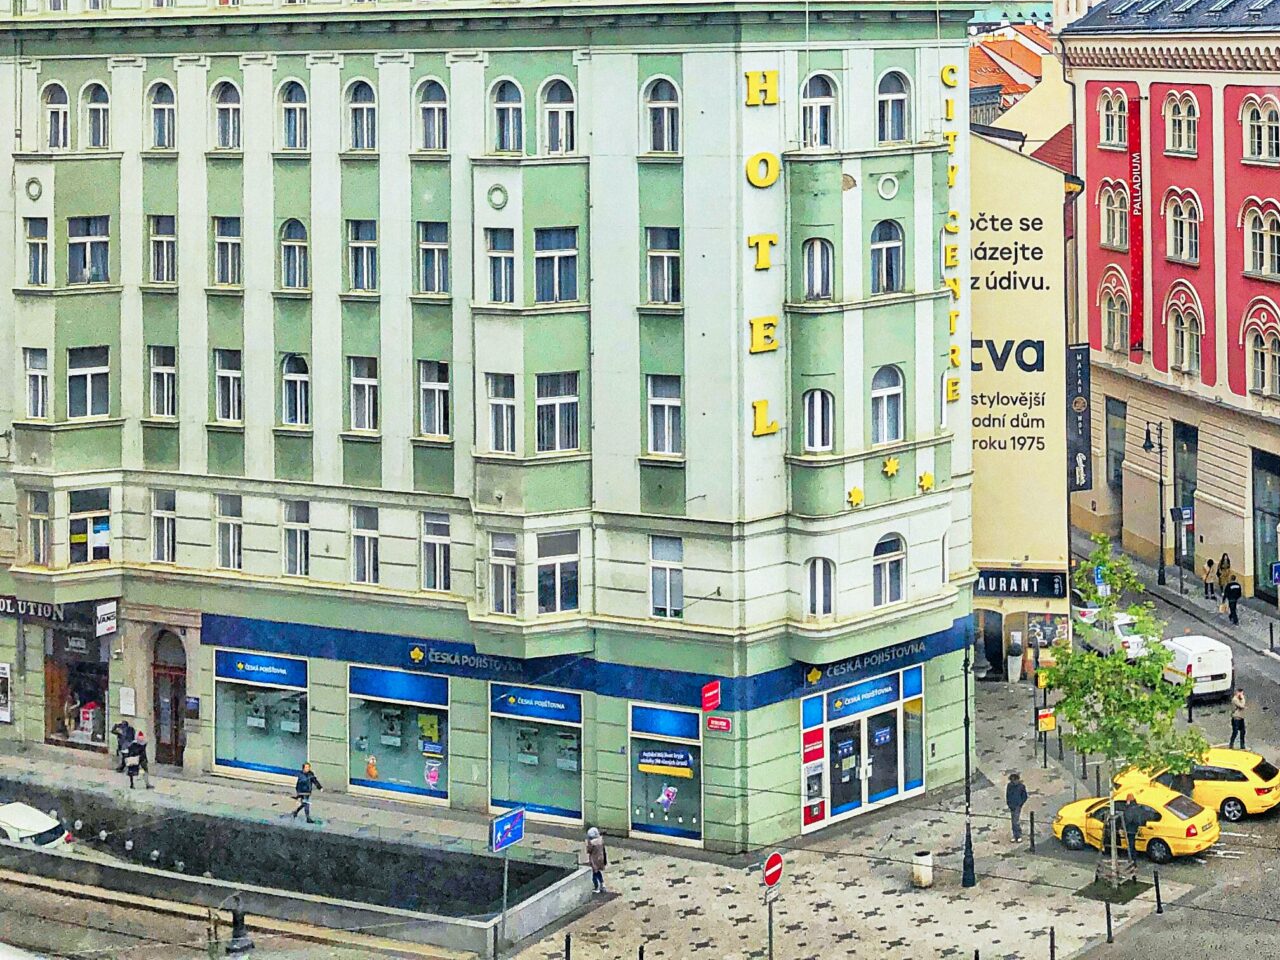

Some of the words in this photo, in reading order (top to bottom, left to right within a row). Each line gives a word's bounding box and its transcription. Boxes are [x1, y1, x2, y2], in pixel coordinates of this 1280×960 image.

[940, 65, 959, 189] CITY
[1132, 152, 1142, 216] PALLADIUM
[1019, 217, 1043, 231] se
[745, 70, 780, 437] HOTEL
[970, 241, 1043, 265] ázejte
[970, 276, 980, 290] z
[985, 271, 1050, 290] údivu.
[943, 210, 961, 403] CENTRE
[972, 414, 1006, 428] odní
[1010, 412, 1045, 428] dům
[972, 436, 1007, 450] roku
[1010, 436, 1045, 451] 1975
[978, 577, 1039, 592] AURANT
[97, 611, 116, 624] VANS
[428, 647, 461, 665] ČESKÁ
[826, 663, 861, 677] ČESKÁ
[863, 642, 925, 666] POJIŠŤOVNA
